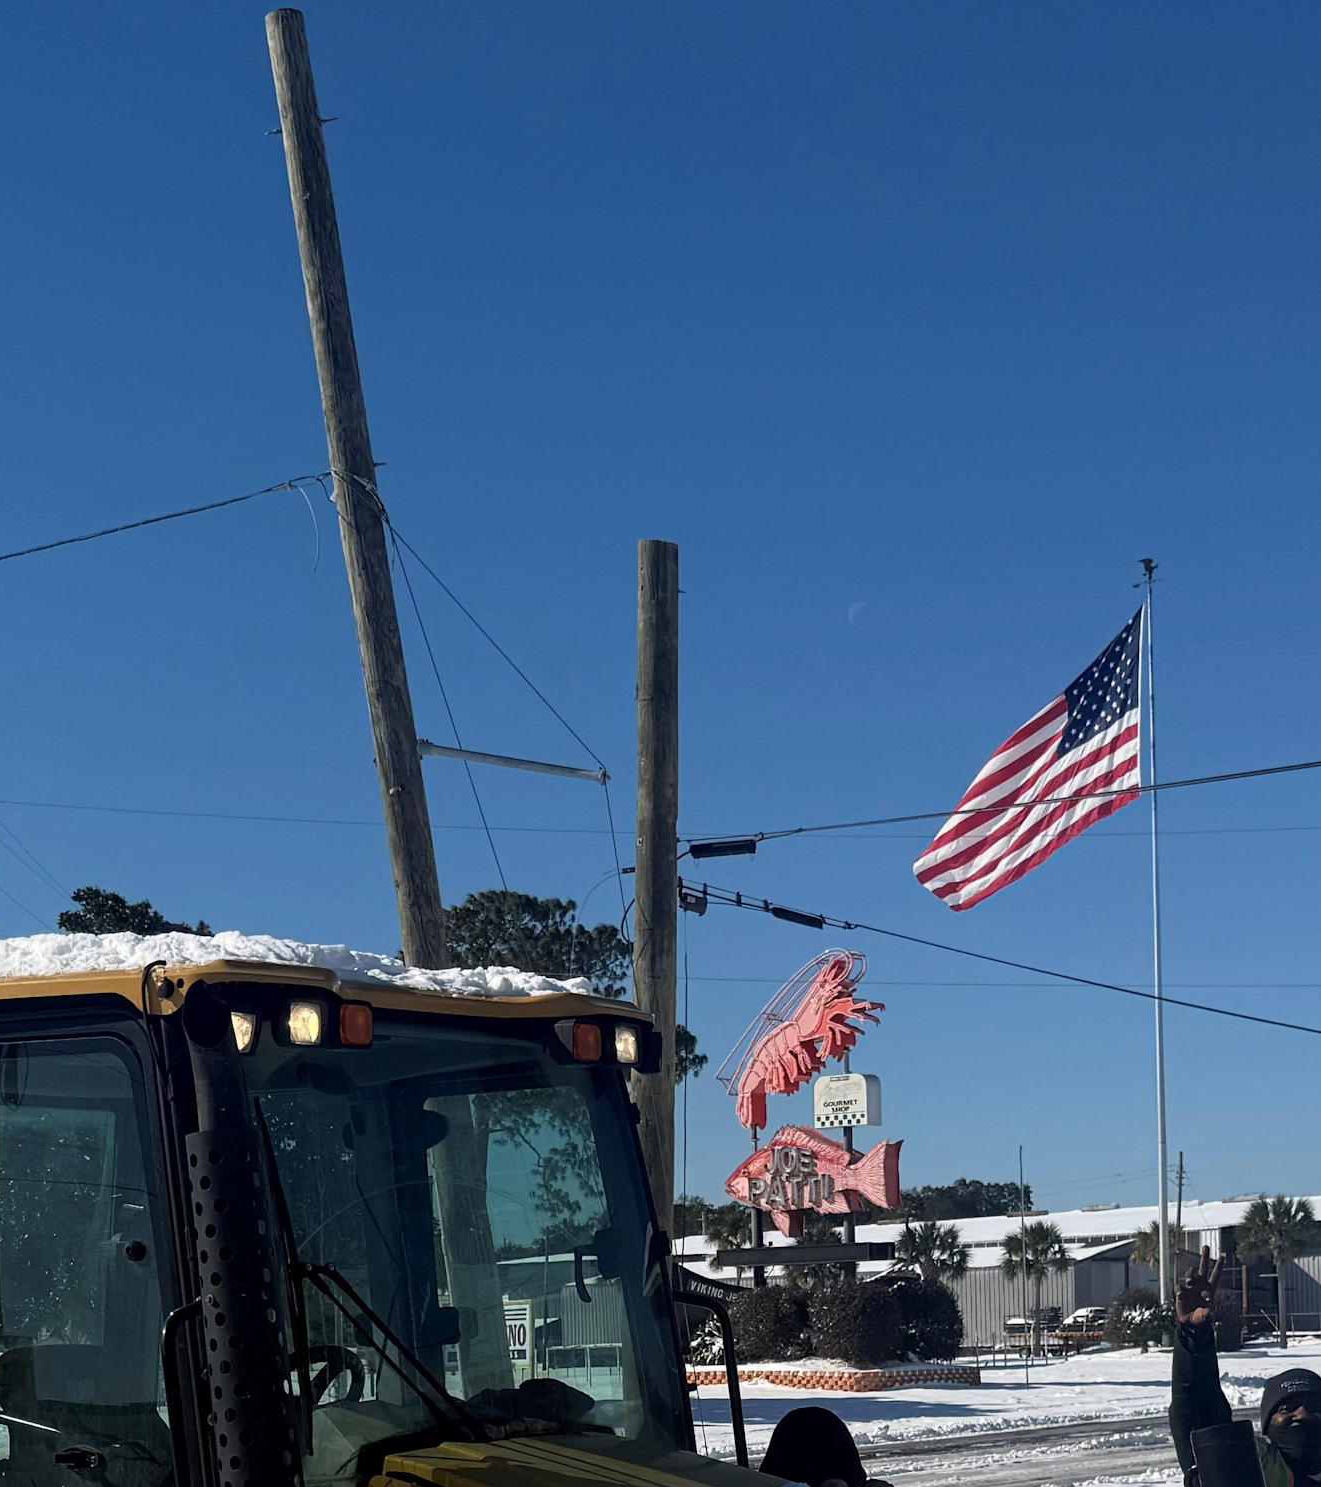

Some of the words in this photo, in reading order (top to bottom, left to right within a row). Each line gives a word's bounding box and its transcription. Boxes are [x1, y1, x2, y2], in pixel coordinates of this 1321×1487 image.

[823, 1099, 858, 1107] GOURMET
[766, 1146, 815, 1175] JOE
[748, 1174, 834, 1209] PATTI
[690, 1280, 725, 1299] VIKING
